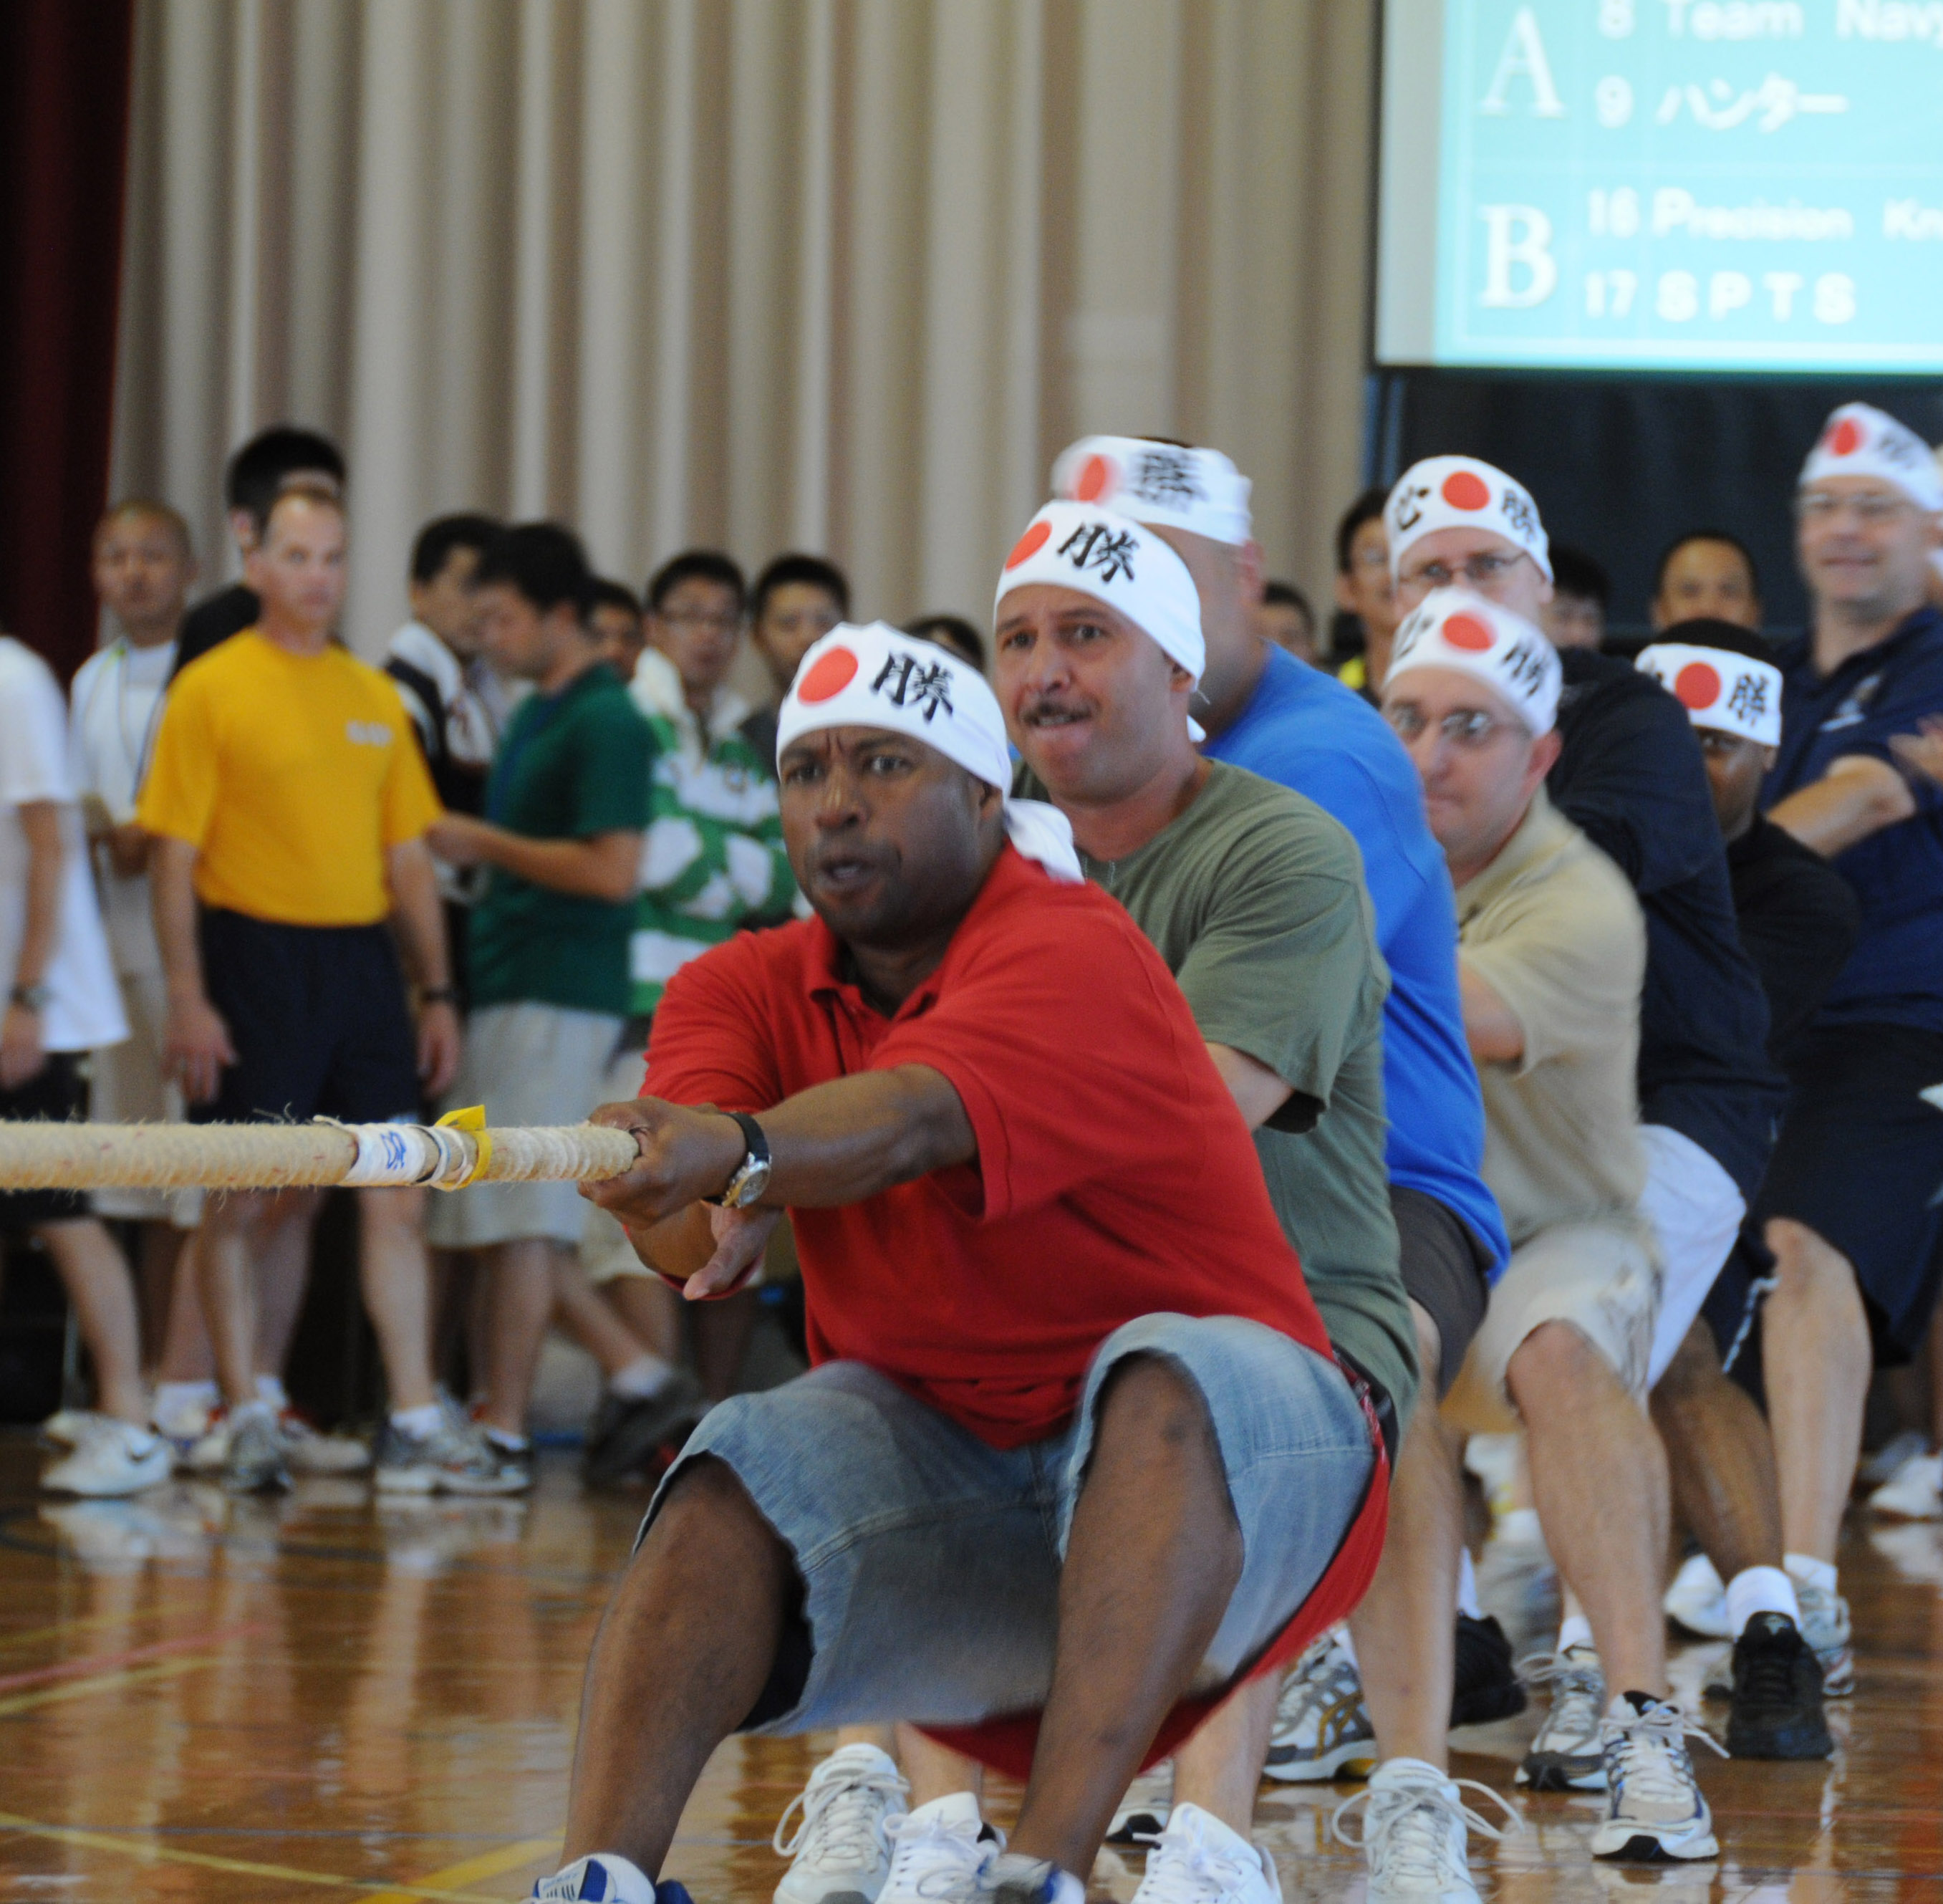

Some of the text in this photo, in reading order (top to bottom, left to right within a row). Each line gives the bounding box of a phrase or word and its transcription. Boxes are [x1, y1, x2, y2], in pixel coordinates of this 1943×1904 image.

[1667, 0, 1803, 40] Team
[1477, 4, 1567, 118] A
[1595, 72, 1848, 133] 9 ハンター
[1588, 186, 1639, 238] 16
[1652, 188, 1853, 241] Precision
[1477, 203, 1557, 309] B
[1586, 269, 1637, 319] 17
[1057, 521, 1139, 584] 勝
[869, 651, 954, 723] 勝
